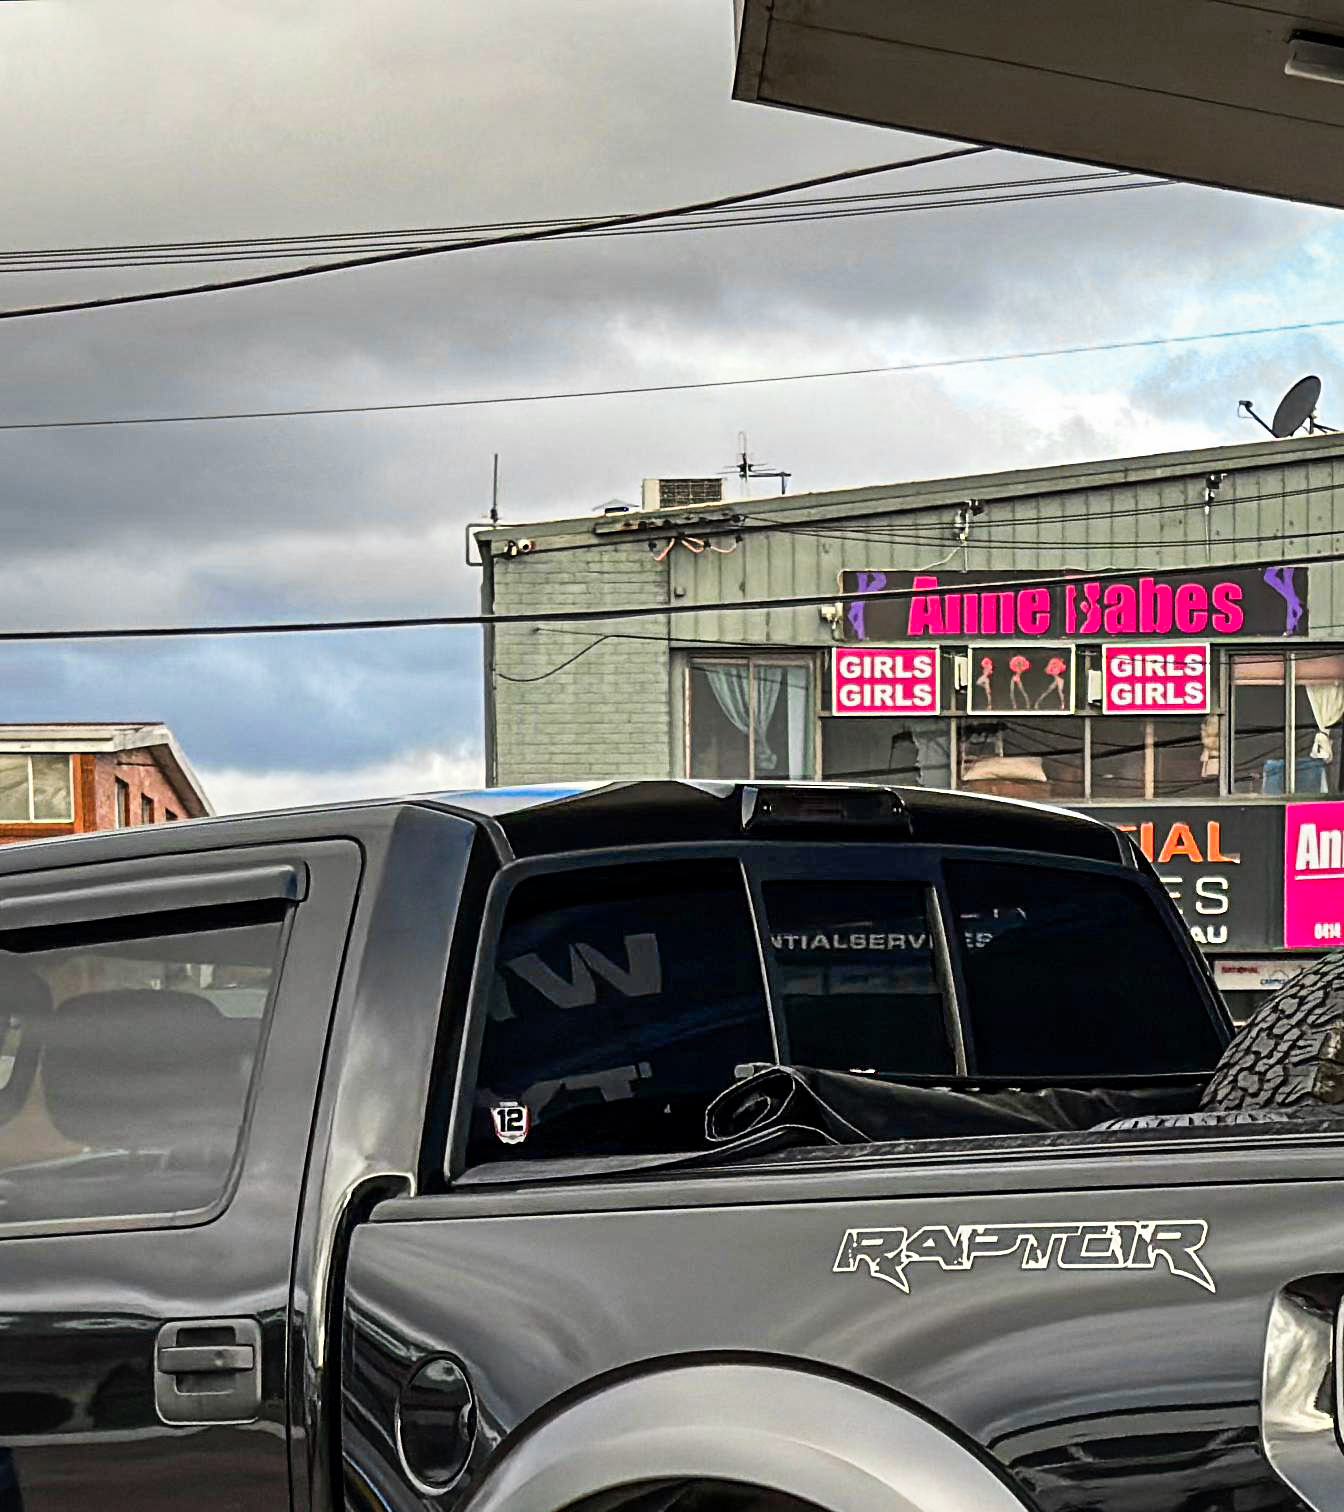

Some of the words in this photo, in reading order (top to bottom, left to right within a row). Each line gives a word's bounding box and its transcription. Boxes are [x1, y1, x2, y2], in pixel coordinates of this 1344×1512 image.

[908, 576, 1050, 636] Anne
[839, 656, 933, 679] GIRLS
[1110, 655, 1203, 678] GIRLS
[839, 683, 933, 707] GIRLS
[1110, 682, 1203, 705] GIRLS
[497, 1109, 524, 1132] 12
[833, 1220, 1216, 1294] RAPTOR
